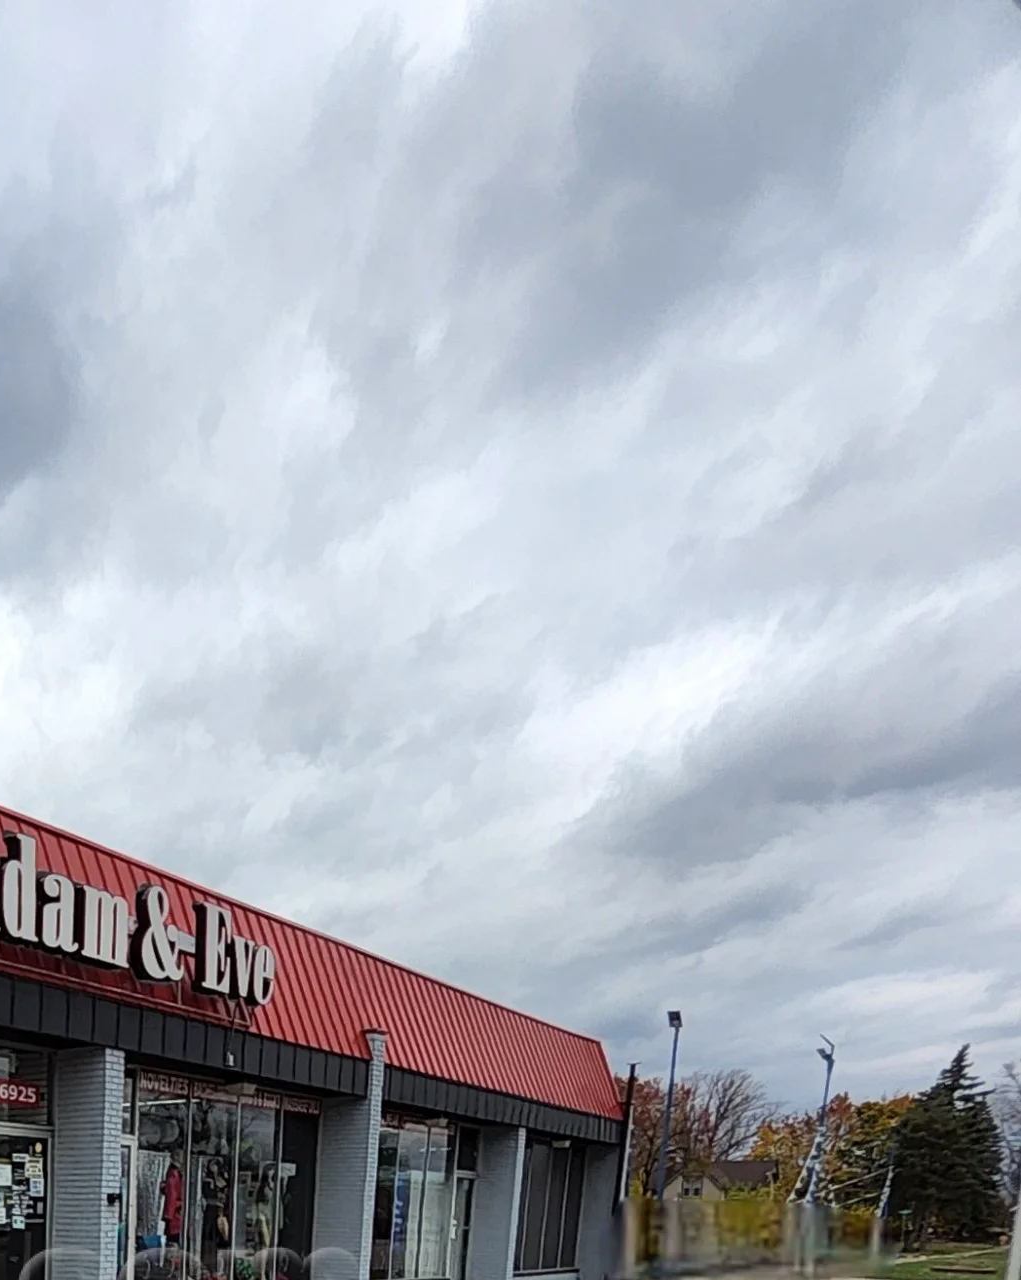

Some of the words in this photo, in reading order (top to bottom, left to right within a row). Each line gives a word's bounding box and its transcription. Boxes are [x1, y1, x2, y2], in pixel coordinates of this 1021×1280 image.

[137, 884, 185, 981] &
[194, 901, 276, 1006] Eve
[140, 1071, 190, 1096] NOVELTIES
